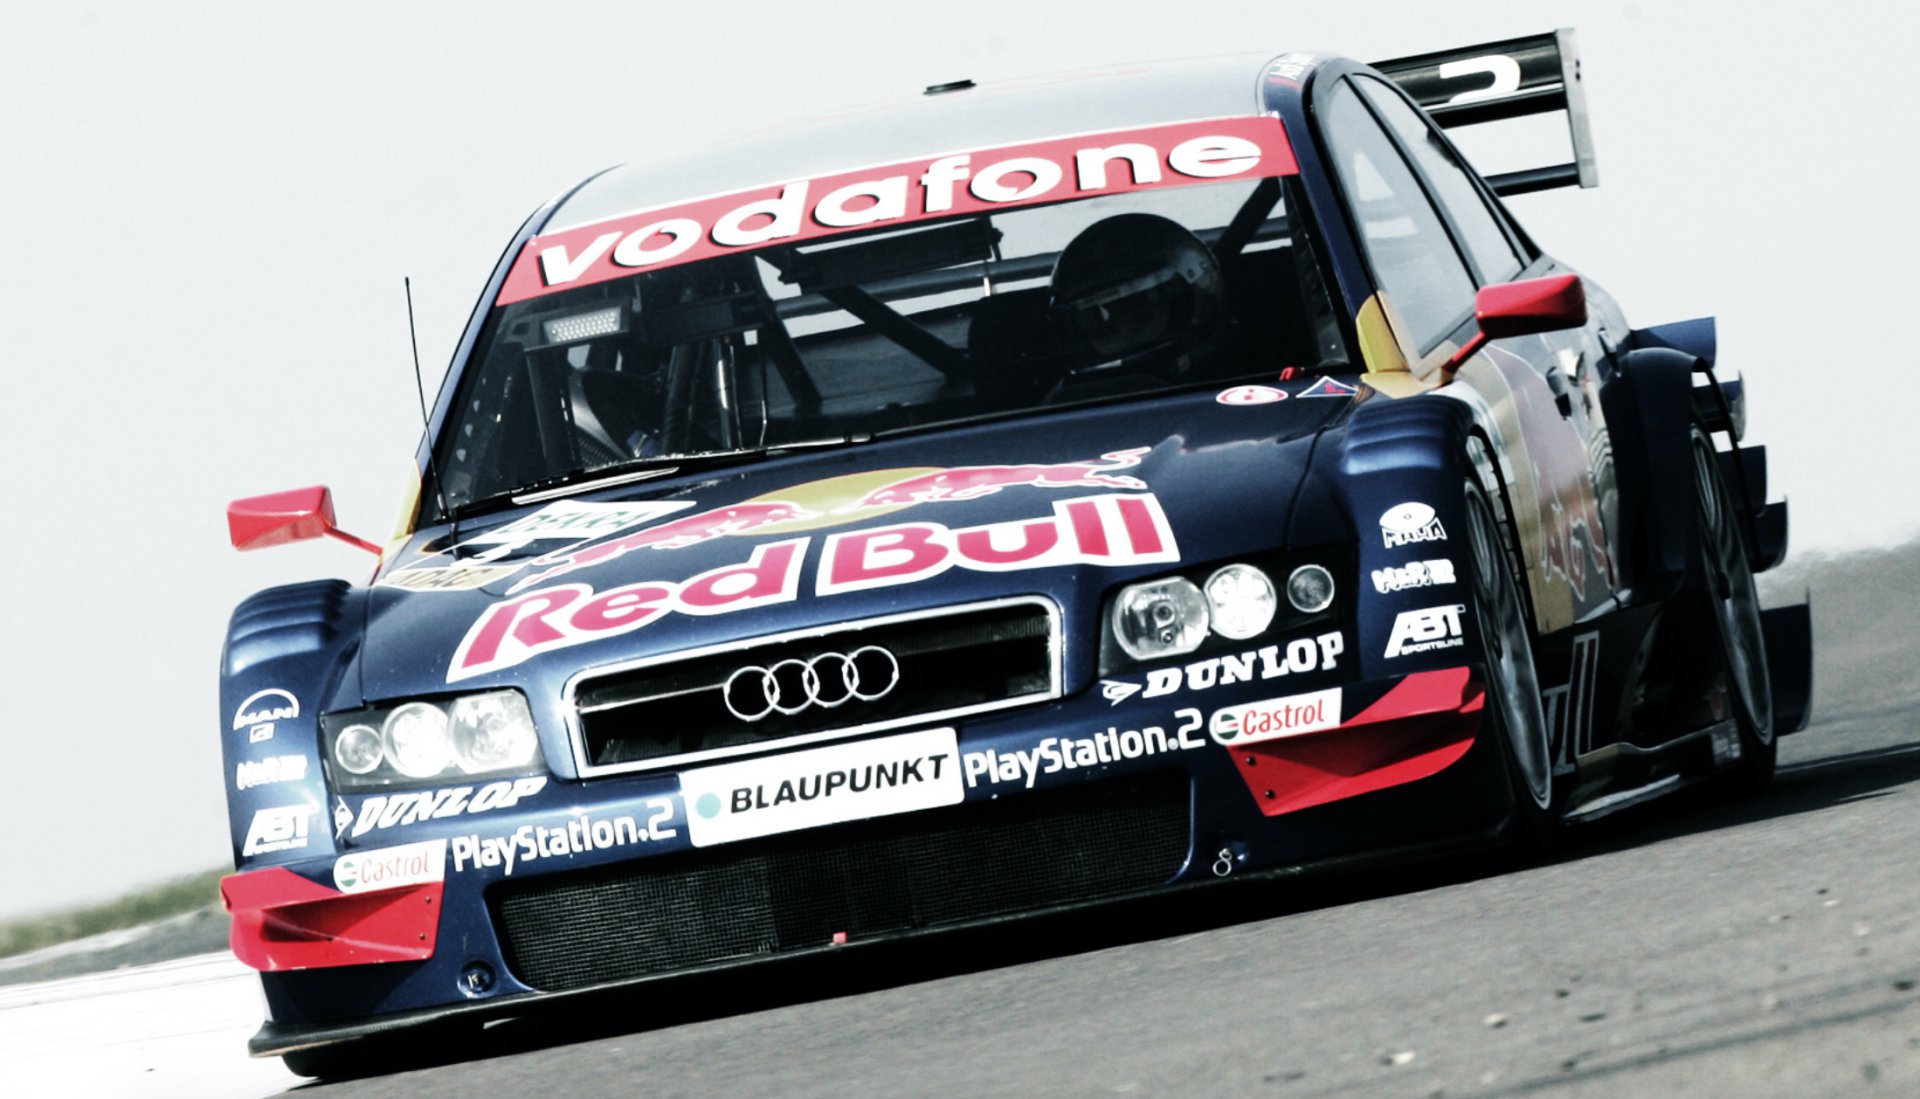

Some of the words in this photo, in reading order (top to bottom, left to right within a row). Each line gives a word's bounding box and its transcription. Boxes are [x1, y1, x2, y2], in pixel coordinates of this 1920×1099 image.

[539, 134, 1263, 288] vodafone
[452, 539, 805, 676] Red
[822, 495, 1173, 590] Bull
[1384, 604, 1466, 658] ABT
[1142, 631, 1344, 699] DUNLOP
[1242, 698, 1325, 736] Castrol
[351, 775, 548, 838] DUNLOP
[730, 753, 949, 814] BLAUPUNKT
[243, 804, 318, 857] ABT
[361, 851, 430, 884] Castrol
